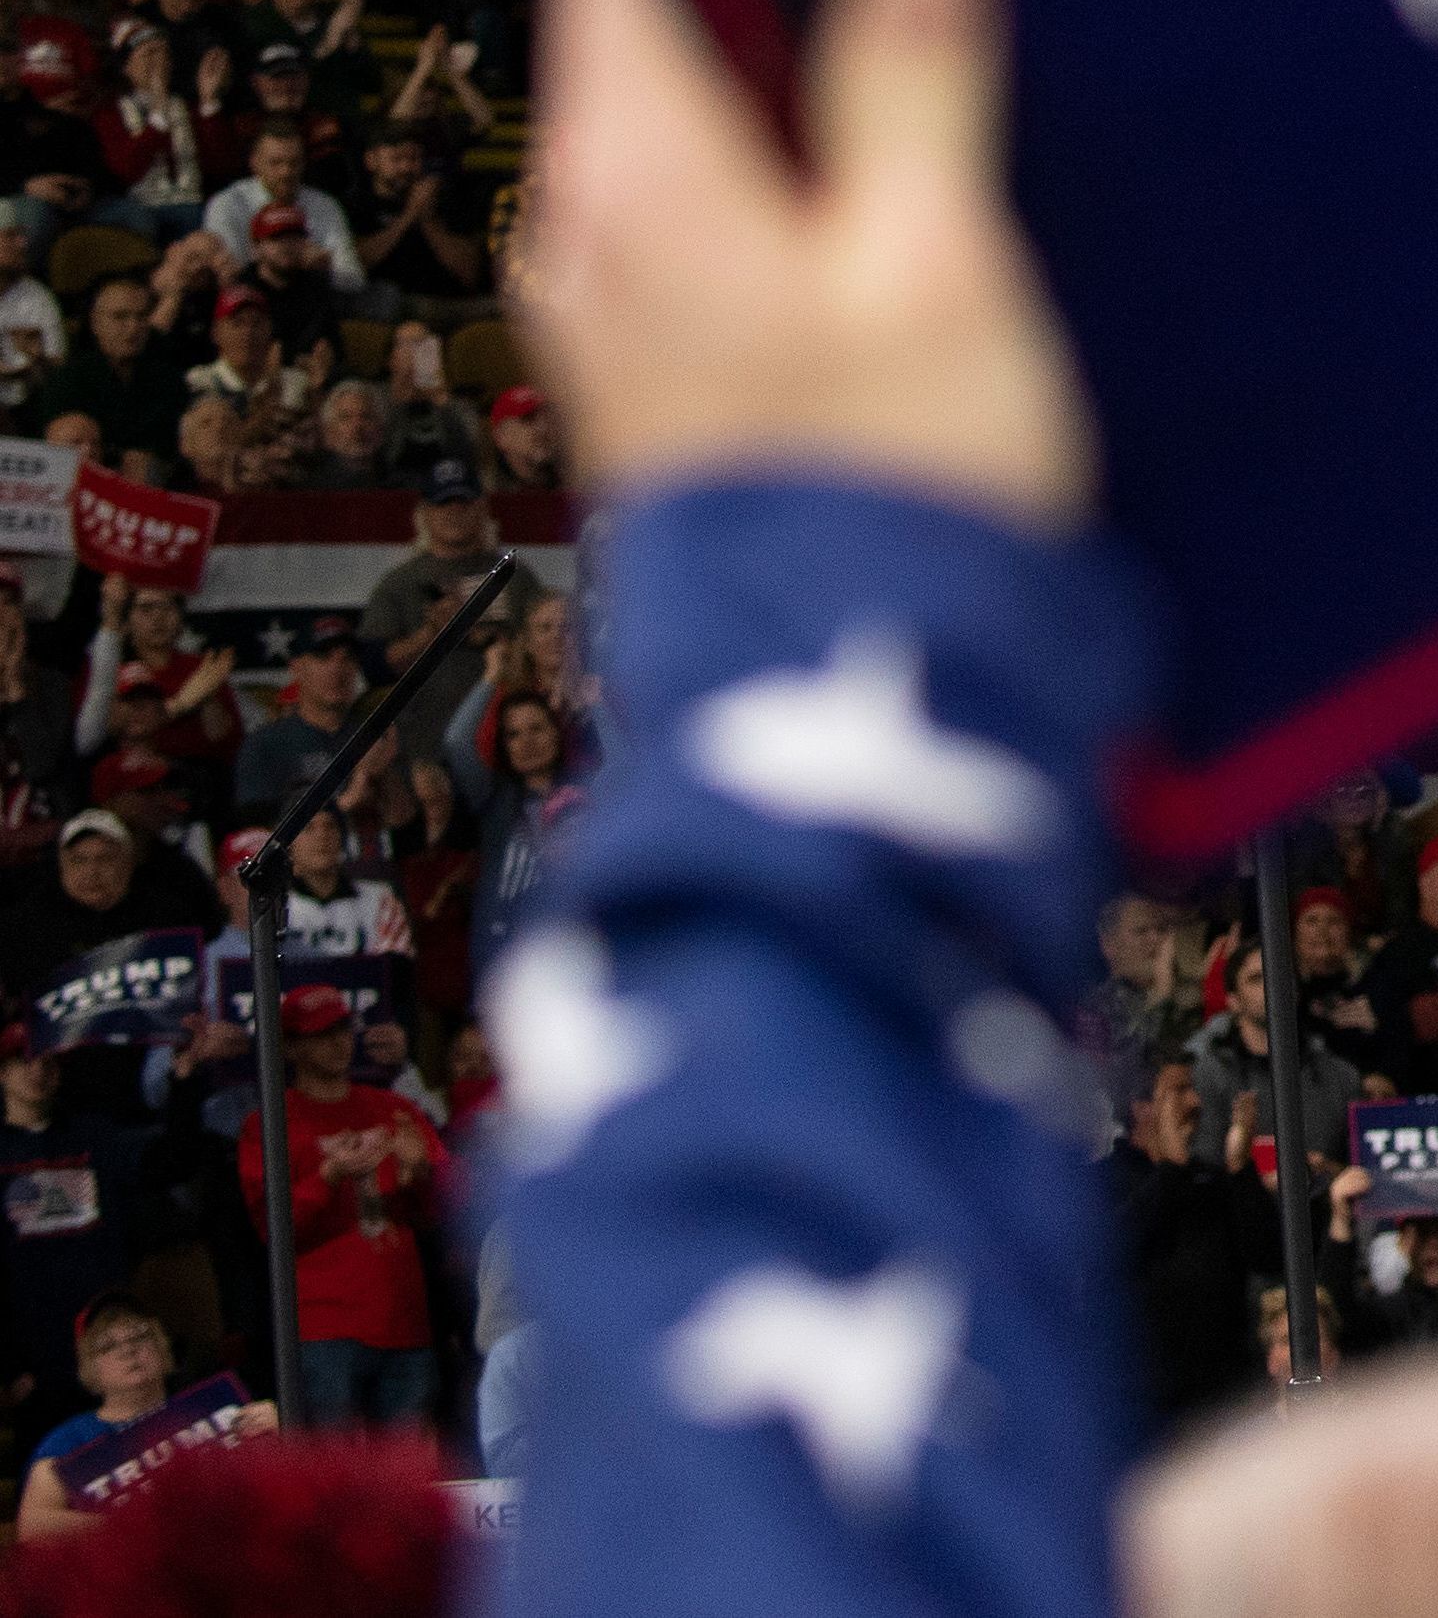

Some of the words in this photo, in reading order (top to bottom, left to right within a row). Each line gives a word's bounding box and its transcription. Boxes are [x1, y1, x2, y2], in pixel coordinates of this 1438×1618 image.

[0, 452, 48, 476] EEP
[79, 488, 199, 546] TRUMP
[35, 955, 194, 1012] TRUMP
[82, 1403, 242, 1501] TRUMP
[474, 1502, 520, 1529] KE
